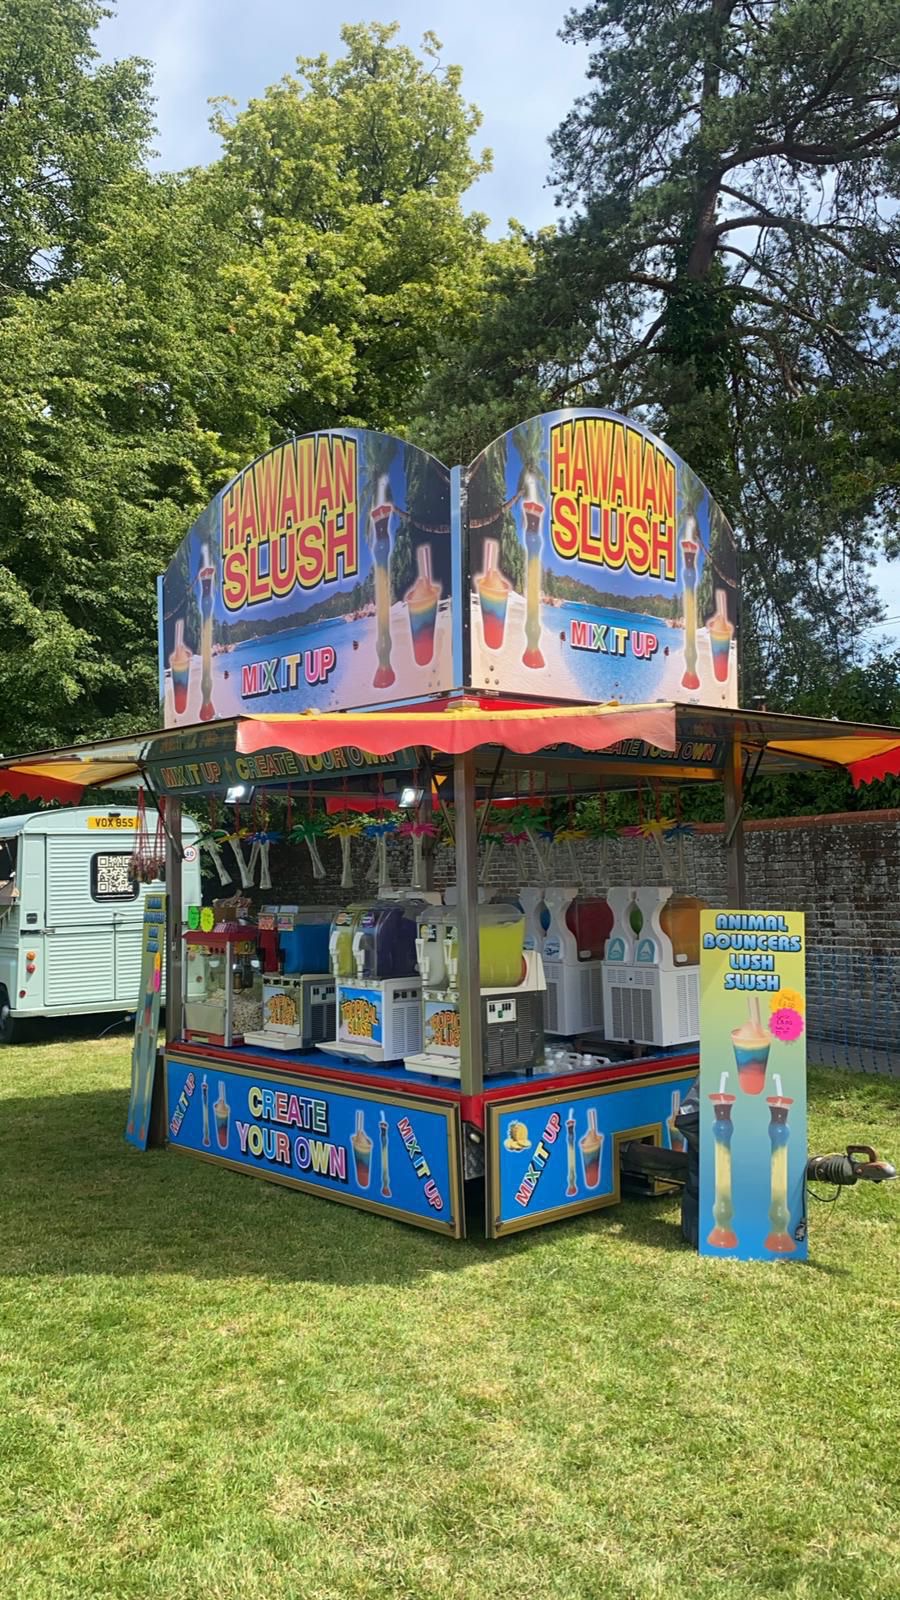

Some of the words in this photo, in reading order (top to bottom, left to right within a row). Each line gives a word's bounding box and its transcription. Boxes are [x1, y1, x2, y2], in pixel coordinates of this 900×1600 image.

[550, 416, 676, 520] HAWAIIAN
[222, 433, 357, 555] HAWAIIAN
[551, 488, 676, 582] SLUSH
[222, 508, 358, 613] SLUSH
[570, 620, 608, 652] MIX
[609, 627, 629, 656] IT
[630, 631, 658, 660] UP
[241, 658, 279, 699] MIX
[280, 653, 301, 690] IT
[303, 645, 336, 684] UP
[160, 766, 190, 788] MIX
[184, 764, 201, 785] IT
[200, 761, 221, 784] UP
[235, 751, 299, 780] CREATE
[298, 748, 348, 773] YOUR
[681, 742, 717, 761] OWN
[703, 933, 802, 952] BOUNCERS
[715, 913, 789, 932] ANIMAL
[724, 973, 780, 991] SLUSH
[729, 953, 775, 971] LUSH
[178, 1091, 189, 1113] IT
[183, 1072, 196, 1097] UP
[248, 1086, 329, 1135] CREATE
[235, 1120, 291, 1166] YOUR
[294, 1136, 347, 1181] OWN
[397, 1116, 422, 1160] MIX
[413, 1155, 431, 1178] IT
[423, 1178, 443, 1211] UP
[515, 1162, 543, 1208] MIX
[532, 1140, 551, 1168] IT
[542, 1112, 561, 1144] UP
